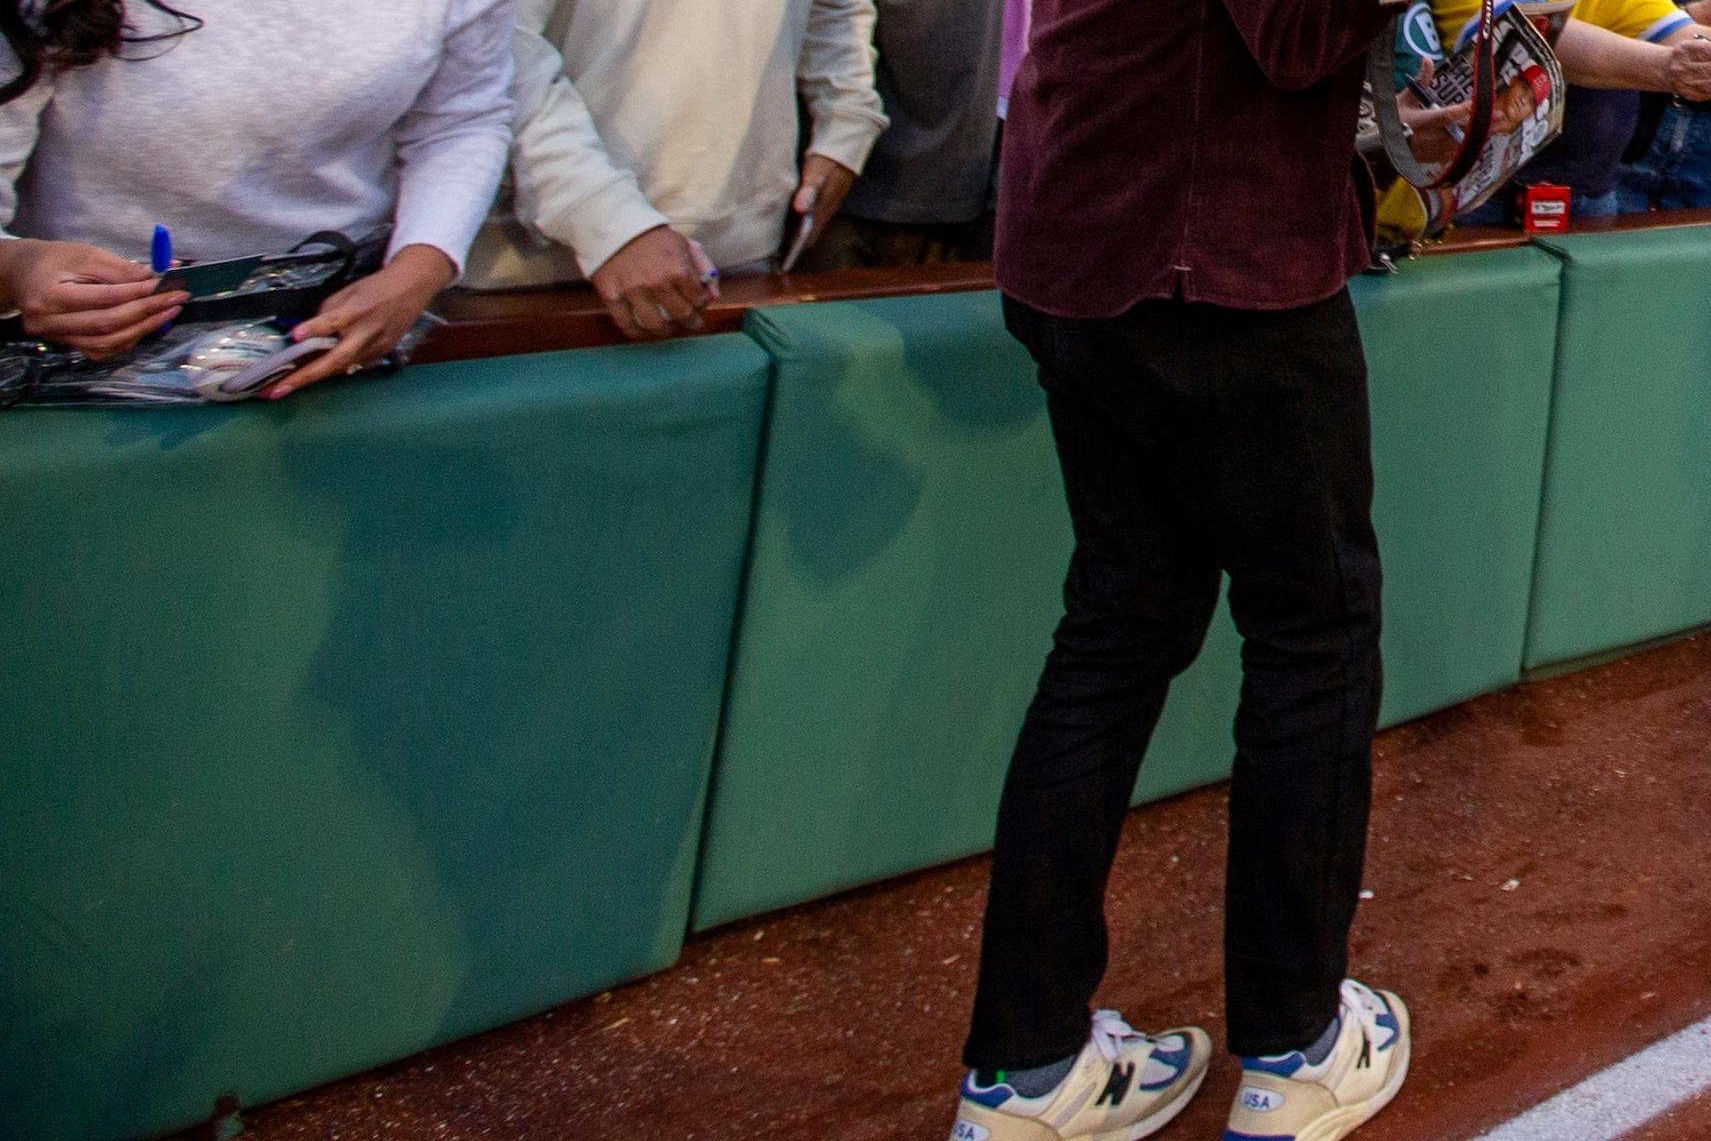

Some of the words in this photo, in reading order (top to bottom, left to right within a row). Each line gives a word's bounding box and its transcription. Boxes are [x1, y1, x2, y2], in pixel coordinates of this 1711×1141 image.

[1430, 71, 1466, 108] SUP
[1095, 1060, 1136, 1107] N
[1244, 1091, 1270, 1109] USA
